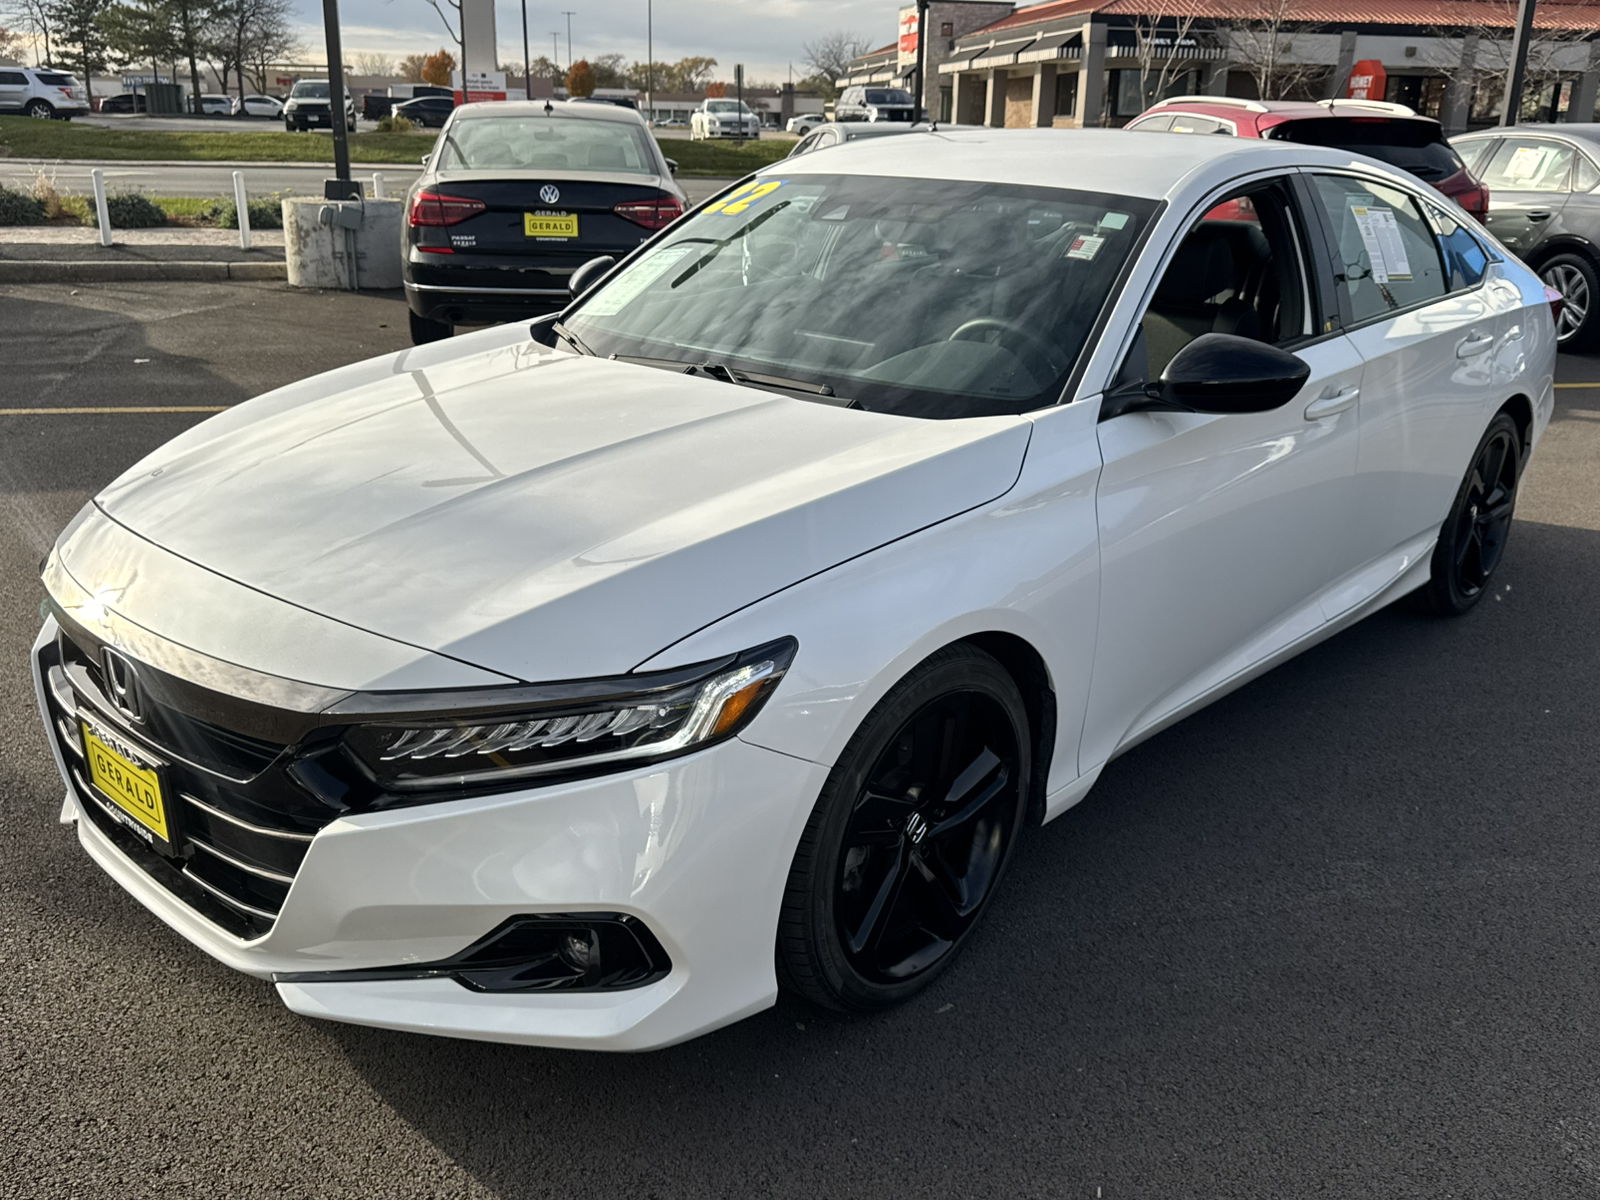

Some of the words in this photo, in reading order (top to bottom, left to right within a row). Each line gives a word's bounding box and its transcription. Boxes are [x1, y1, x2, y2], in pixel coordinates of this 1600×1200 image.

[1350, 75, 1374, 89] HONEY
[700, 180, 782, 216] 22
[531, 222, 571, 231] GERALD
[96, 753, 155, 810] GERALD
